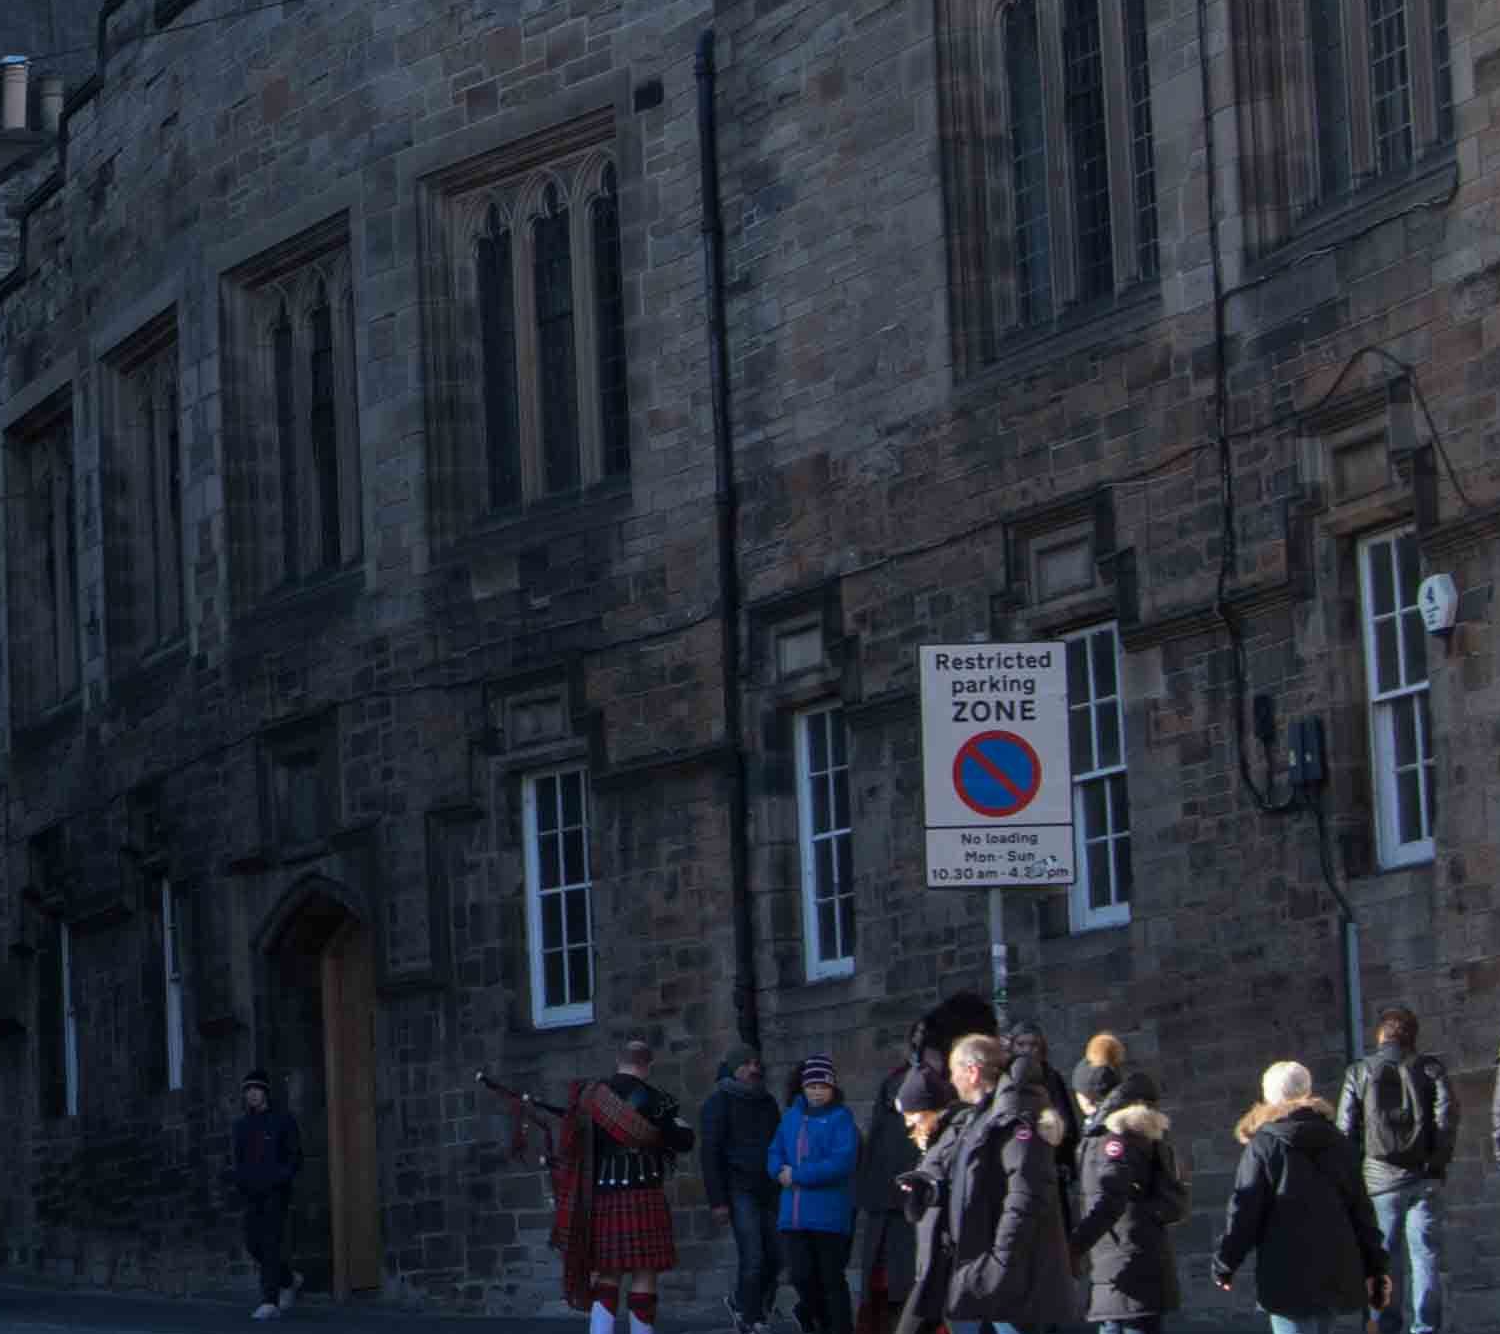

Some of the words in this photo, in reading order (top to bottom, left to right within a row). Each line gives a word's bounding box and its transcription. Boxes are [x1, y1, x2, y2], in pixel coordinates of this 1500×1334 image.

[935, 650, 1052, 671] Restricted
[951, 674, 1036, 698] parking
[951, 699, 1037, 723] ZONE
[960, 833, 982, 845] No
[985, 832, 1039, 845] loading
